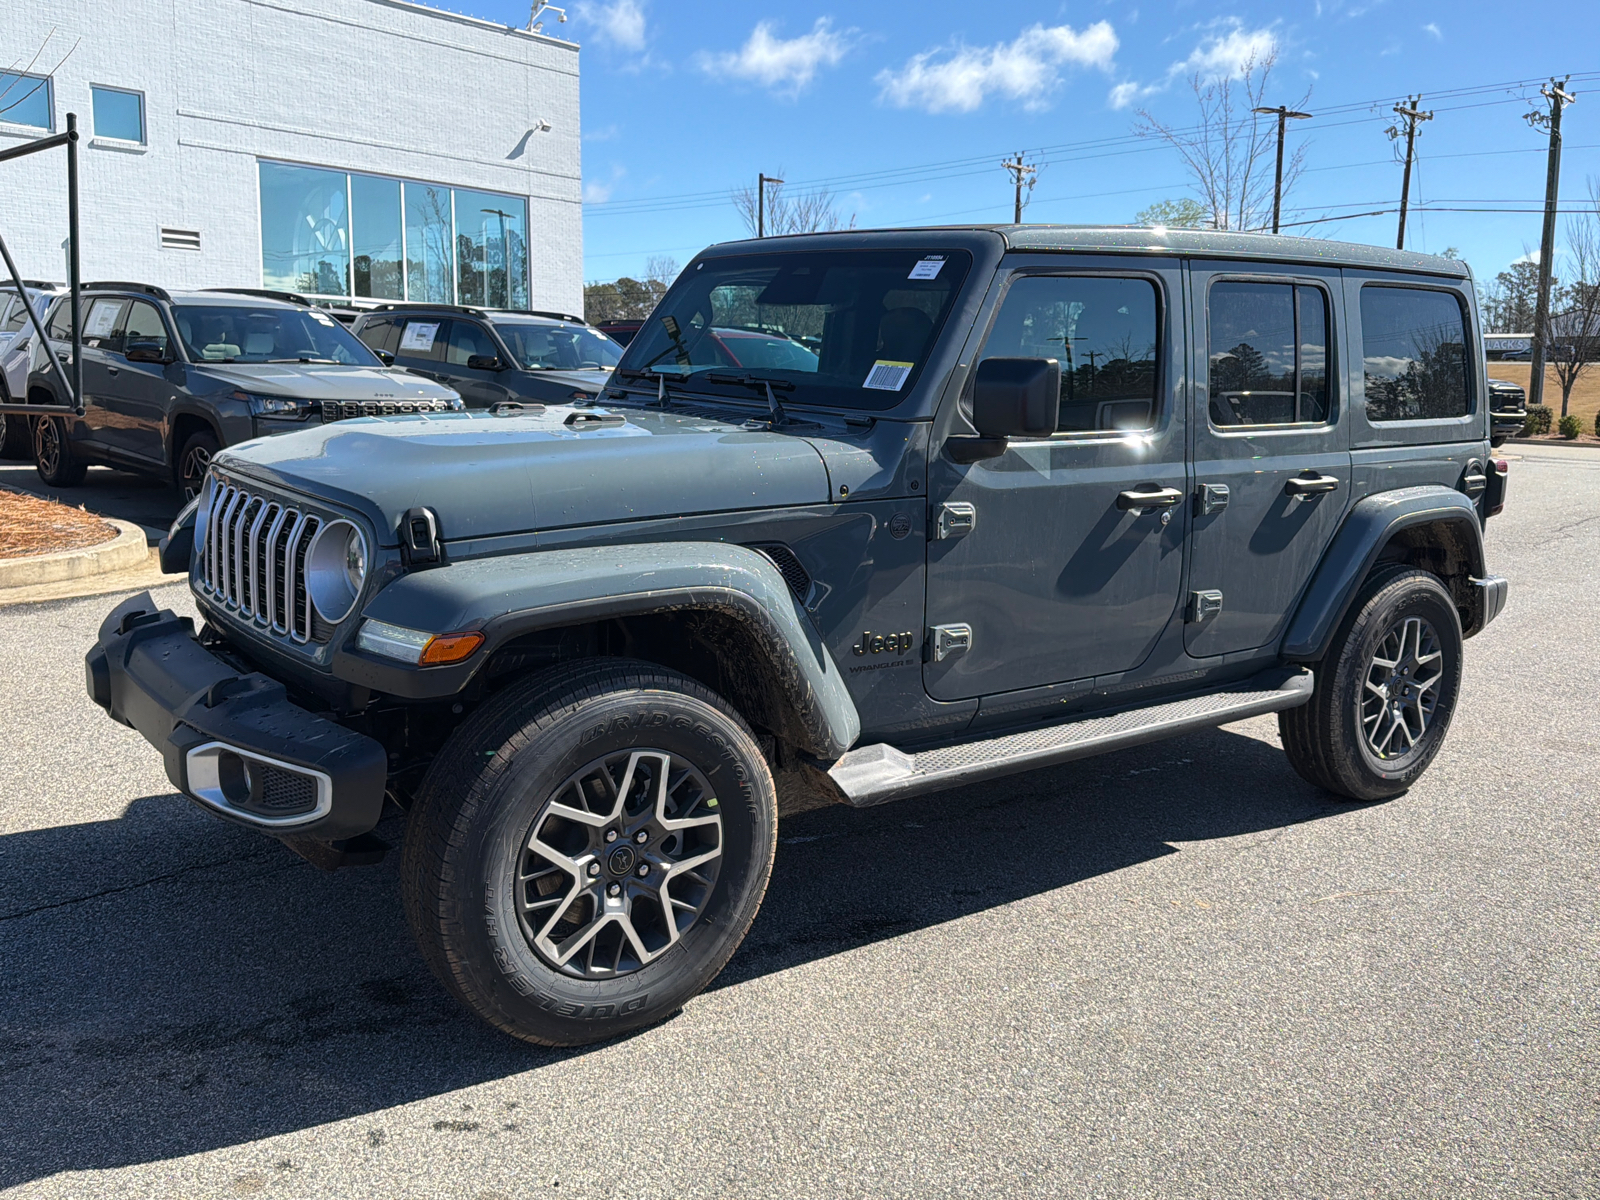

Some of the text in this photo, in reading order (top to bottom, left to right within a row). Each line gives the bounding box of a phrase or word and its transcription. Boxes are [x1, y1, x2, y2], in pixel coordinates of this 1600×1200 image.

[849, 660, 904, 674] WRANGLER
[852, 631, 914, 657] Jeep
[579, 709, 760, 824] BRIDGESTONE
[492, 946, 650, 1020] DUELER
